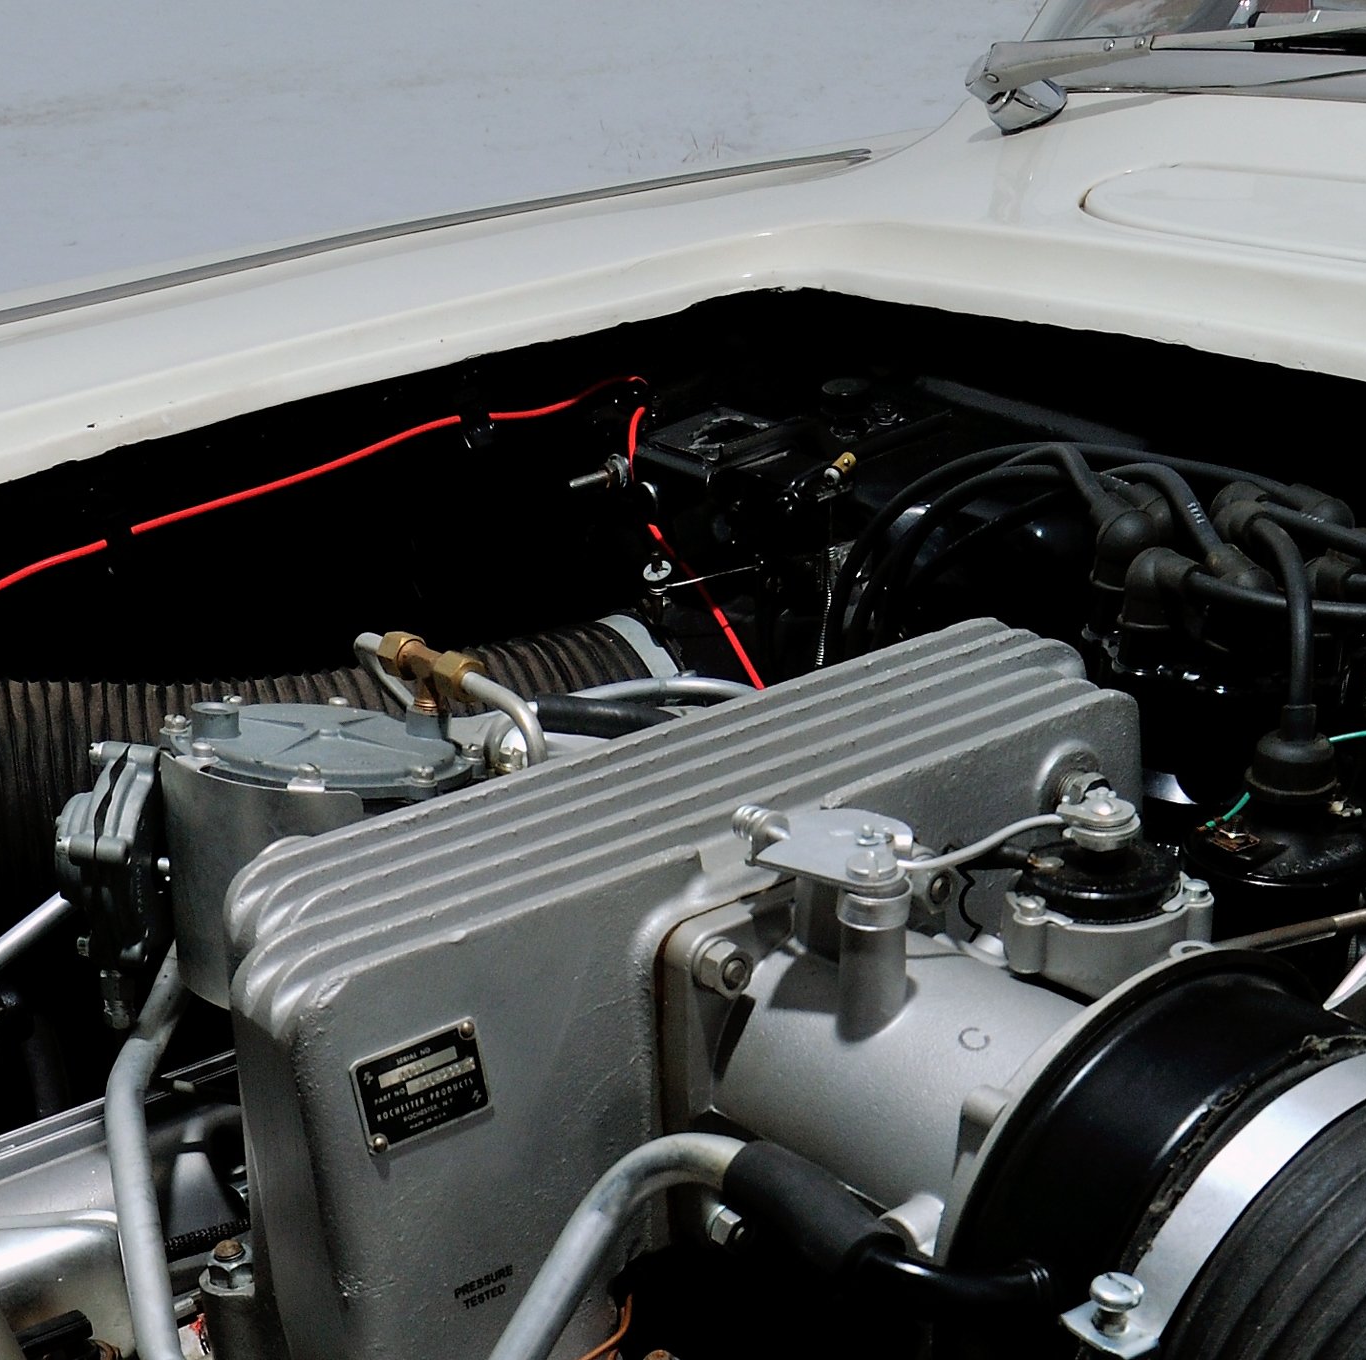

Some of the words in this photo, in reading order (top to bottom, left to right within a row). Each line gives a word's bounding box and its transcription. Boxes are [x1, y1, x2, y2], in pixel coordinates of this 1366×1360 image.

[374, 1092, 391, 1106] PART
[376, 1096, 425, 1122] ROCHESTER
[429, 1077, 474, 1101] PRODUCTS
[453, 1264, 514, 1299] PRESSURE
[462, 1283, 507, 1310] TESTED
